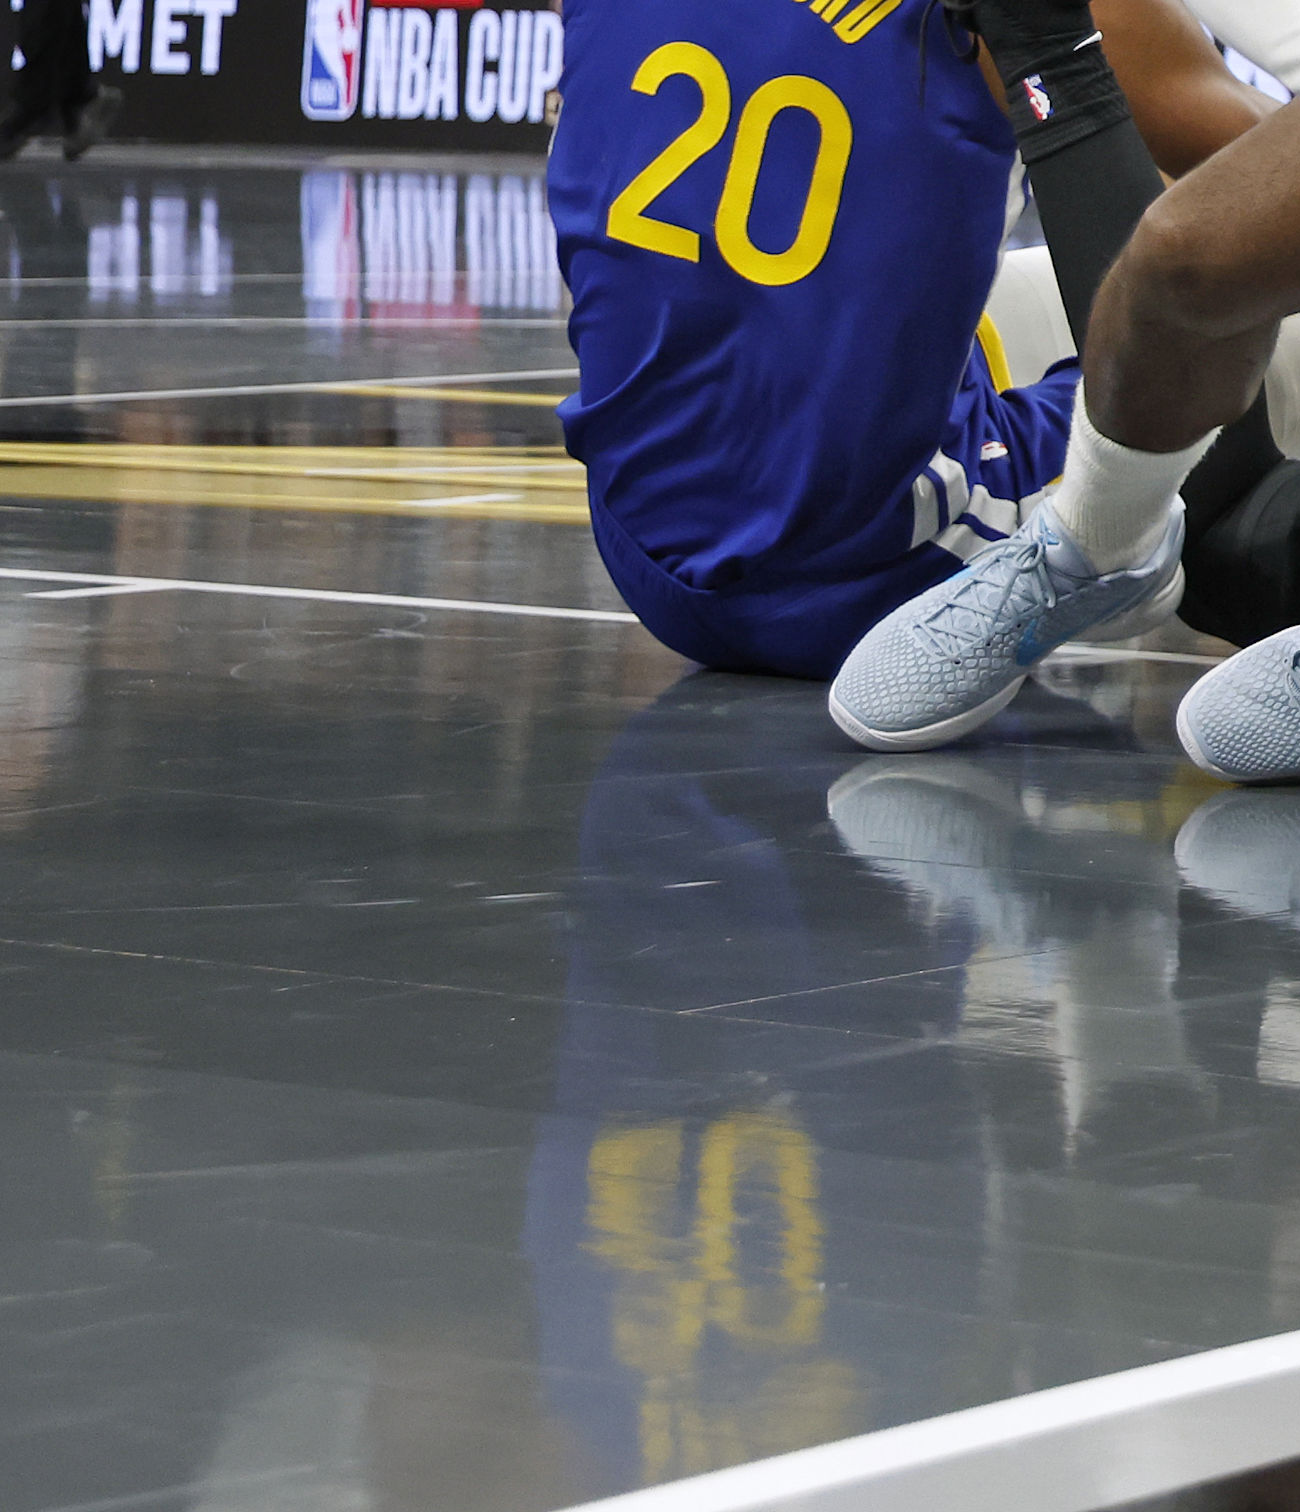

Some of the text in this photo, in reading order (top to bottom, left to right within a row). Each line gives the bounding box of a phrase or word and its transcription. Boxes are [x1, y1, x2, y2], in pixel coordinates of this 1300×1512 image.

[361, 6, 566, 125] NBA CUP
[606, 41, 854, 287] 20
